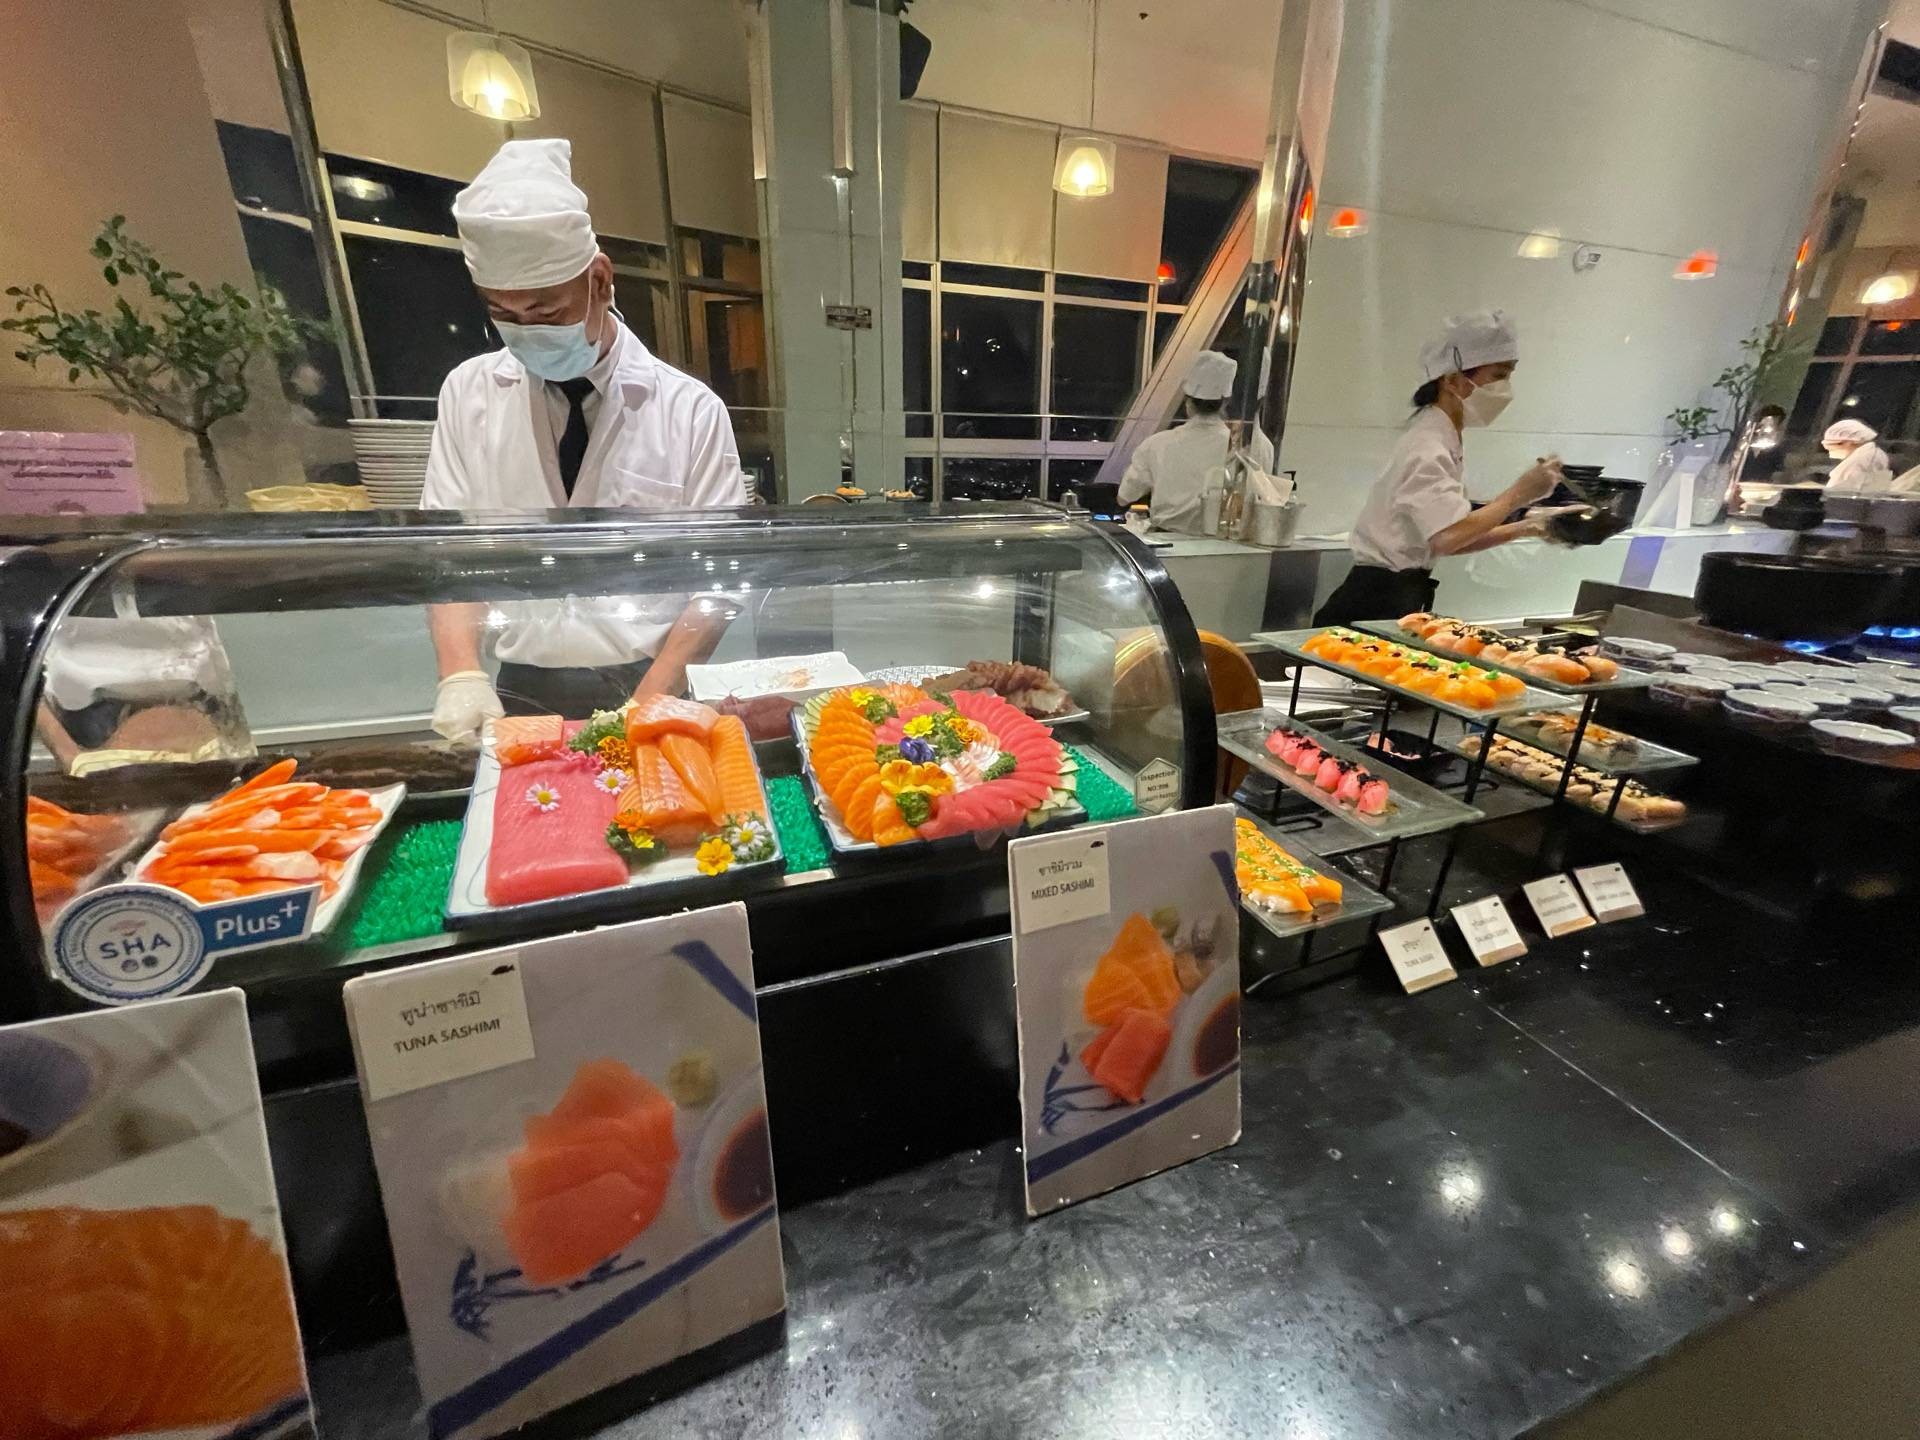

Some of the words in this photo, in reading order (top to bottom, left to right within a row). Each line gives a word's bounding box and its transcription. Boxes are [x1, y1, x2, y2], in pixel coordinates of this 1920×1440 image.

[1031, 886, 1059, 900] MIXED
[1060, 879, 1095, 895] SASHIMI
[99, 933, 172, 960] SHA
[393, 1033, 437, 1053] TUNA
[440, 1018, 501, 1042] SASHIMI
